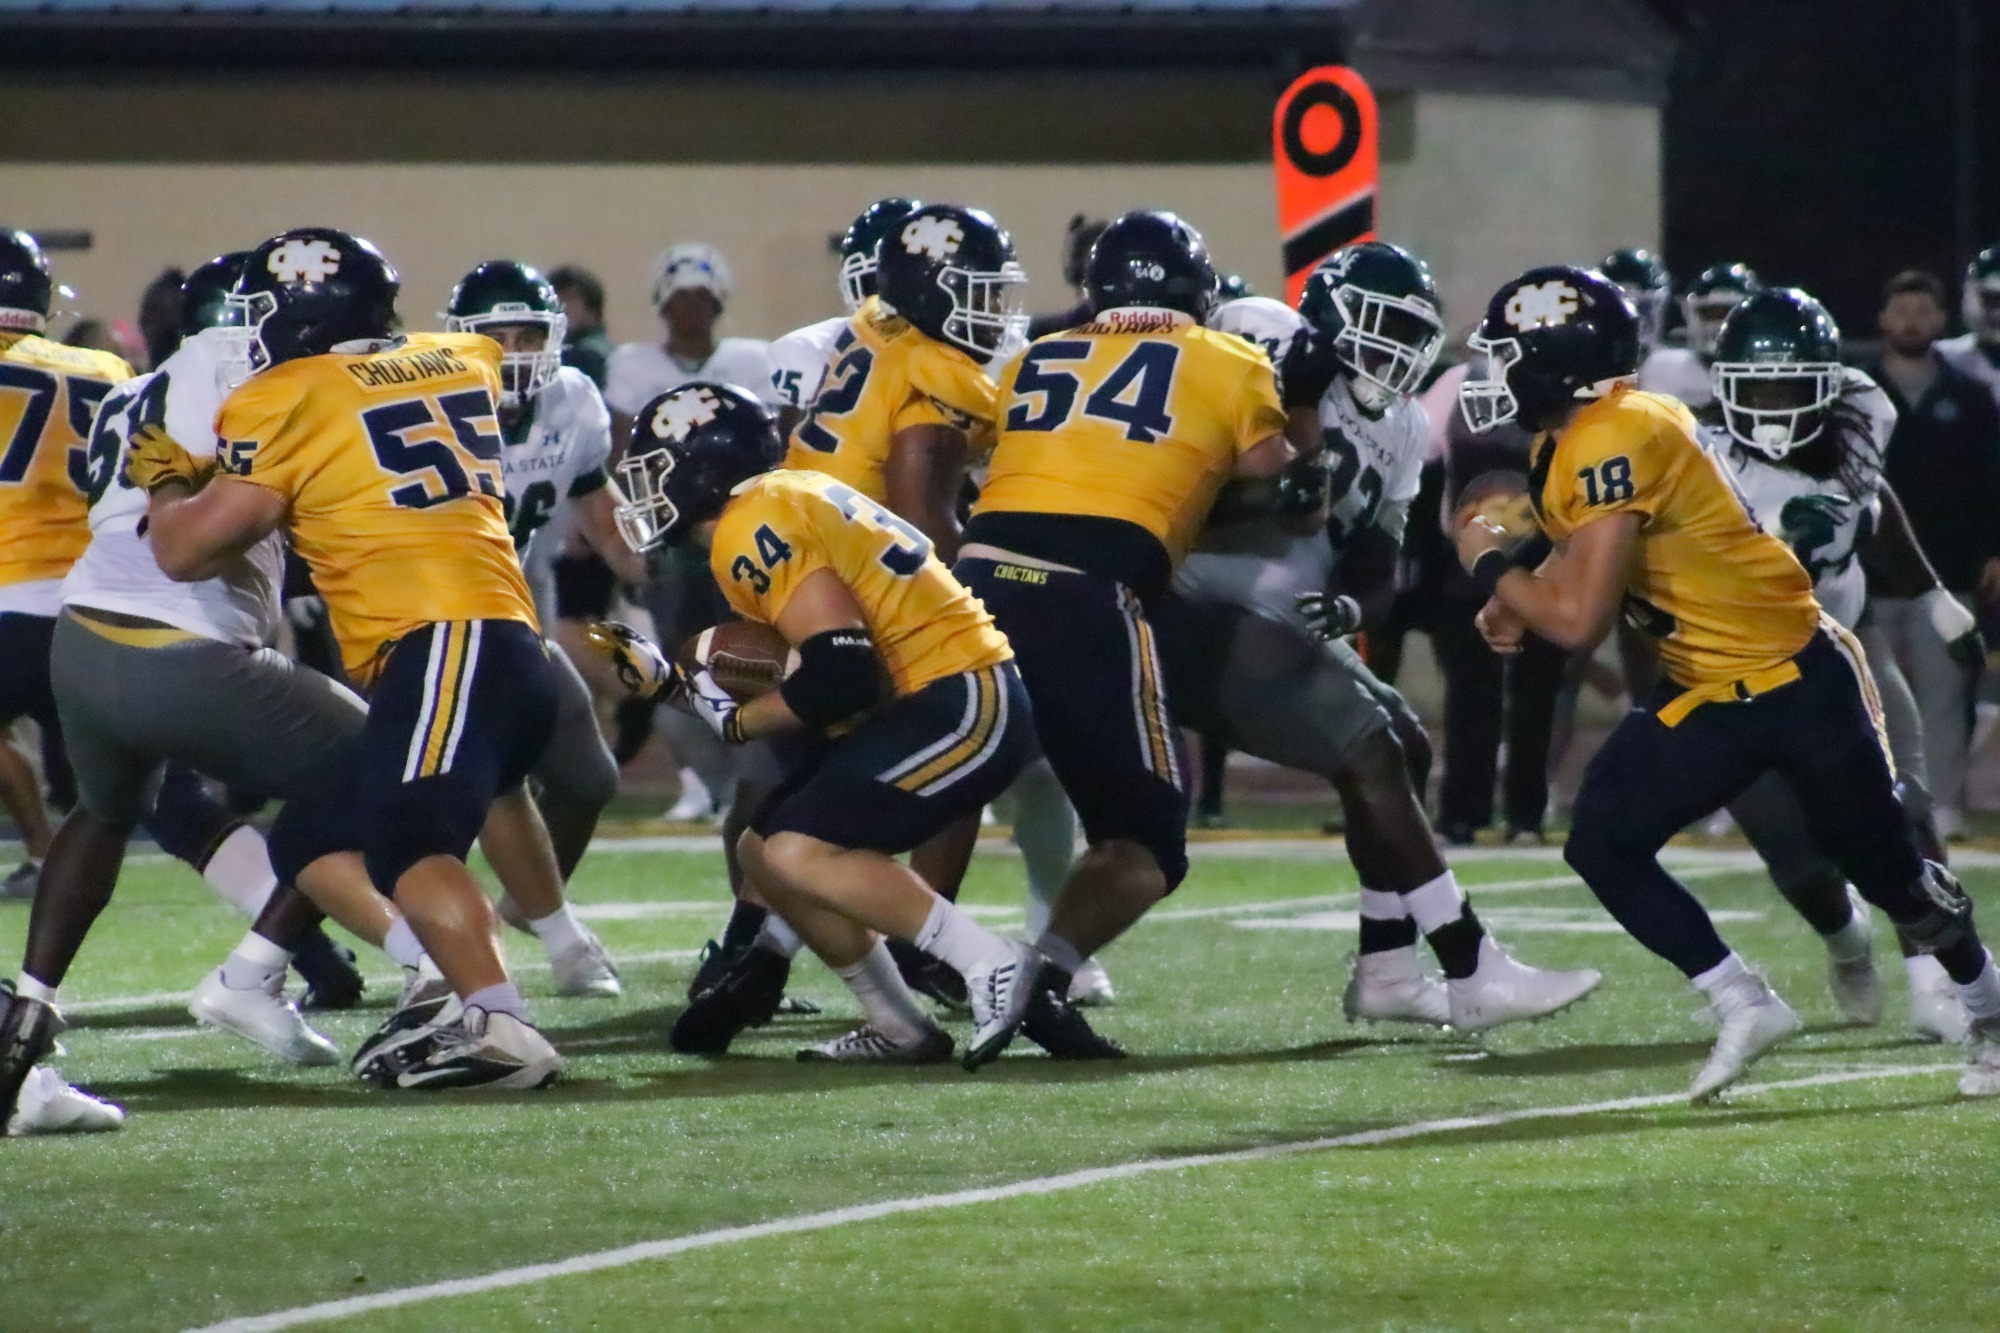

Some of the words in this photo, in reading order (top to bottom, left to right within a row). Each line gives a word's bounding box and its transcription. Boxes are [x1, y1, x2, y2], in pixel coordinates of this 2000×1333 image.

[1110, 311, 1173, 325] Riddell
[347, 347, 468, 387] CHOCTAWS
[1004, 340, 1180, 443] 54
[1578, 456, 1634, 507] 18
[732, 524, 792, 595] 34
[994, 564, 1049, 585] CHOCTAWS
